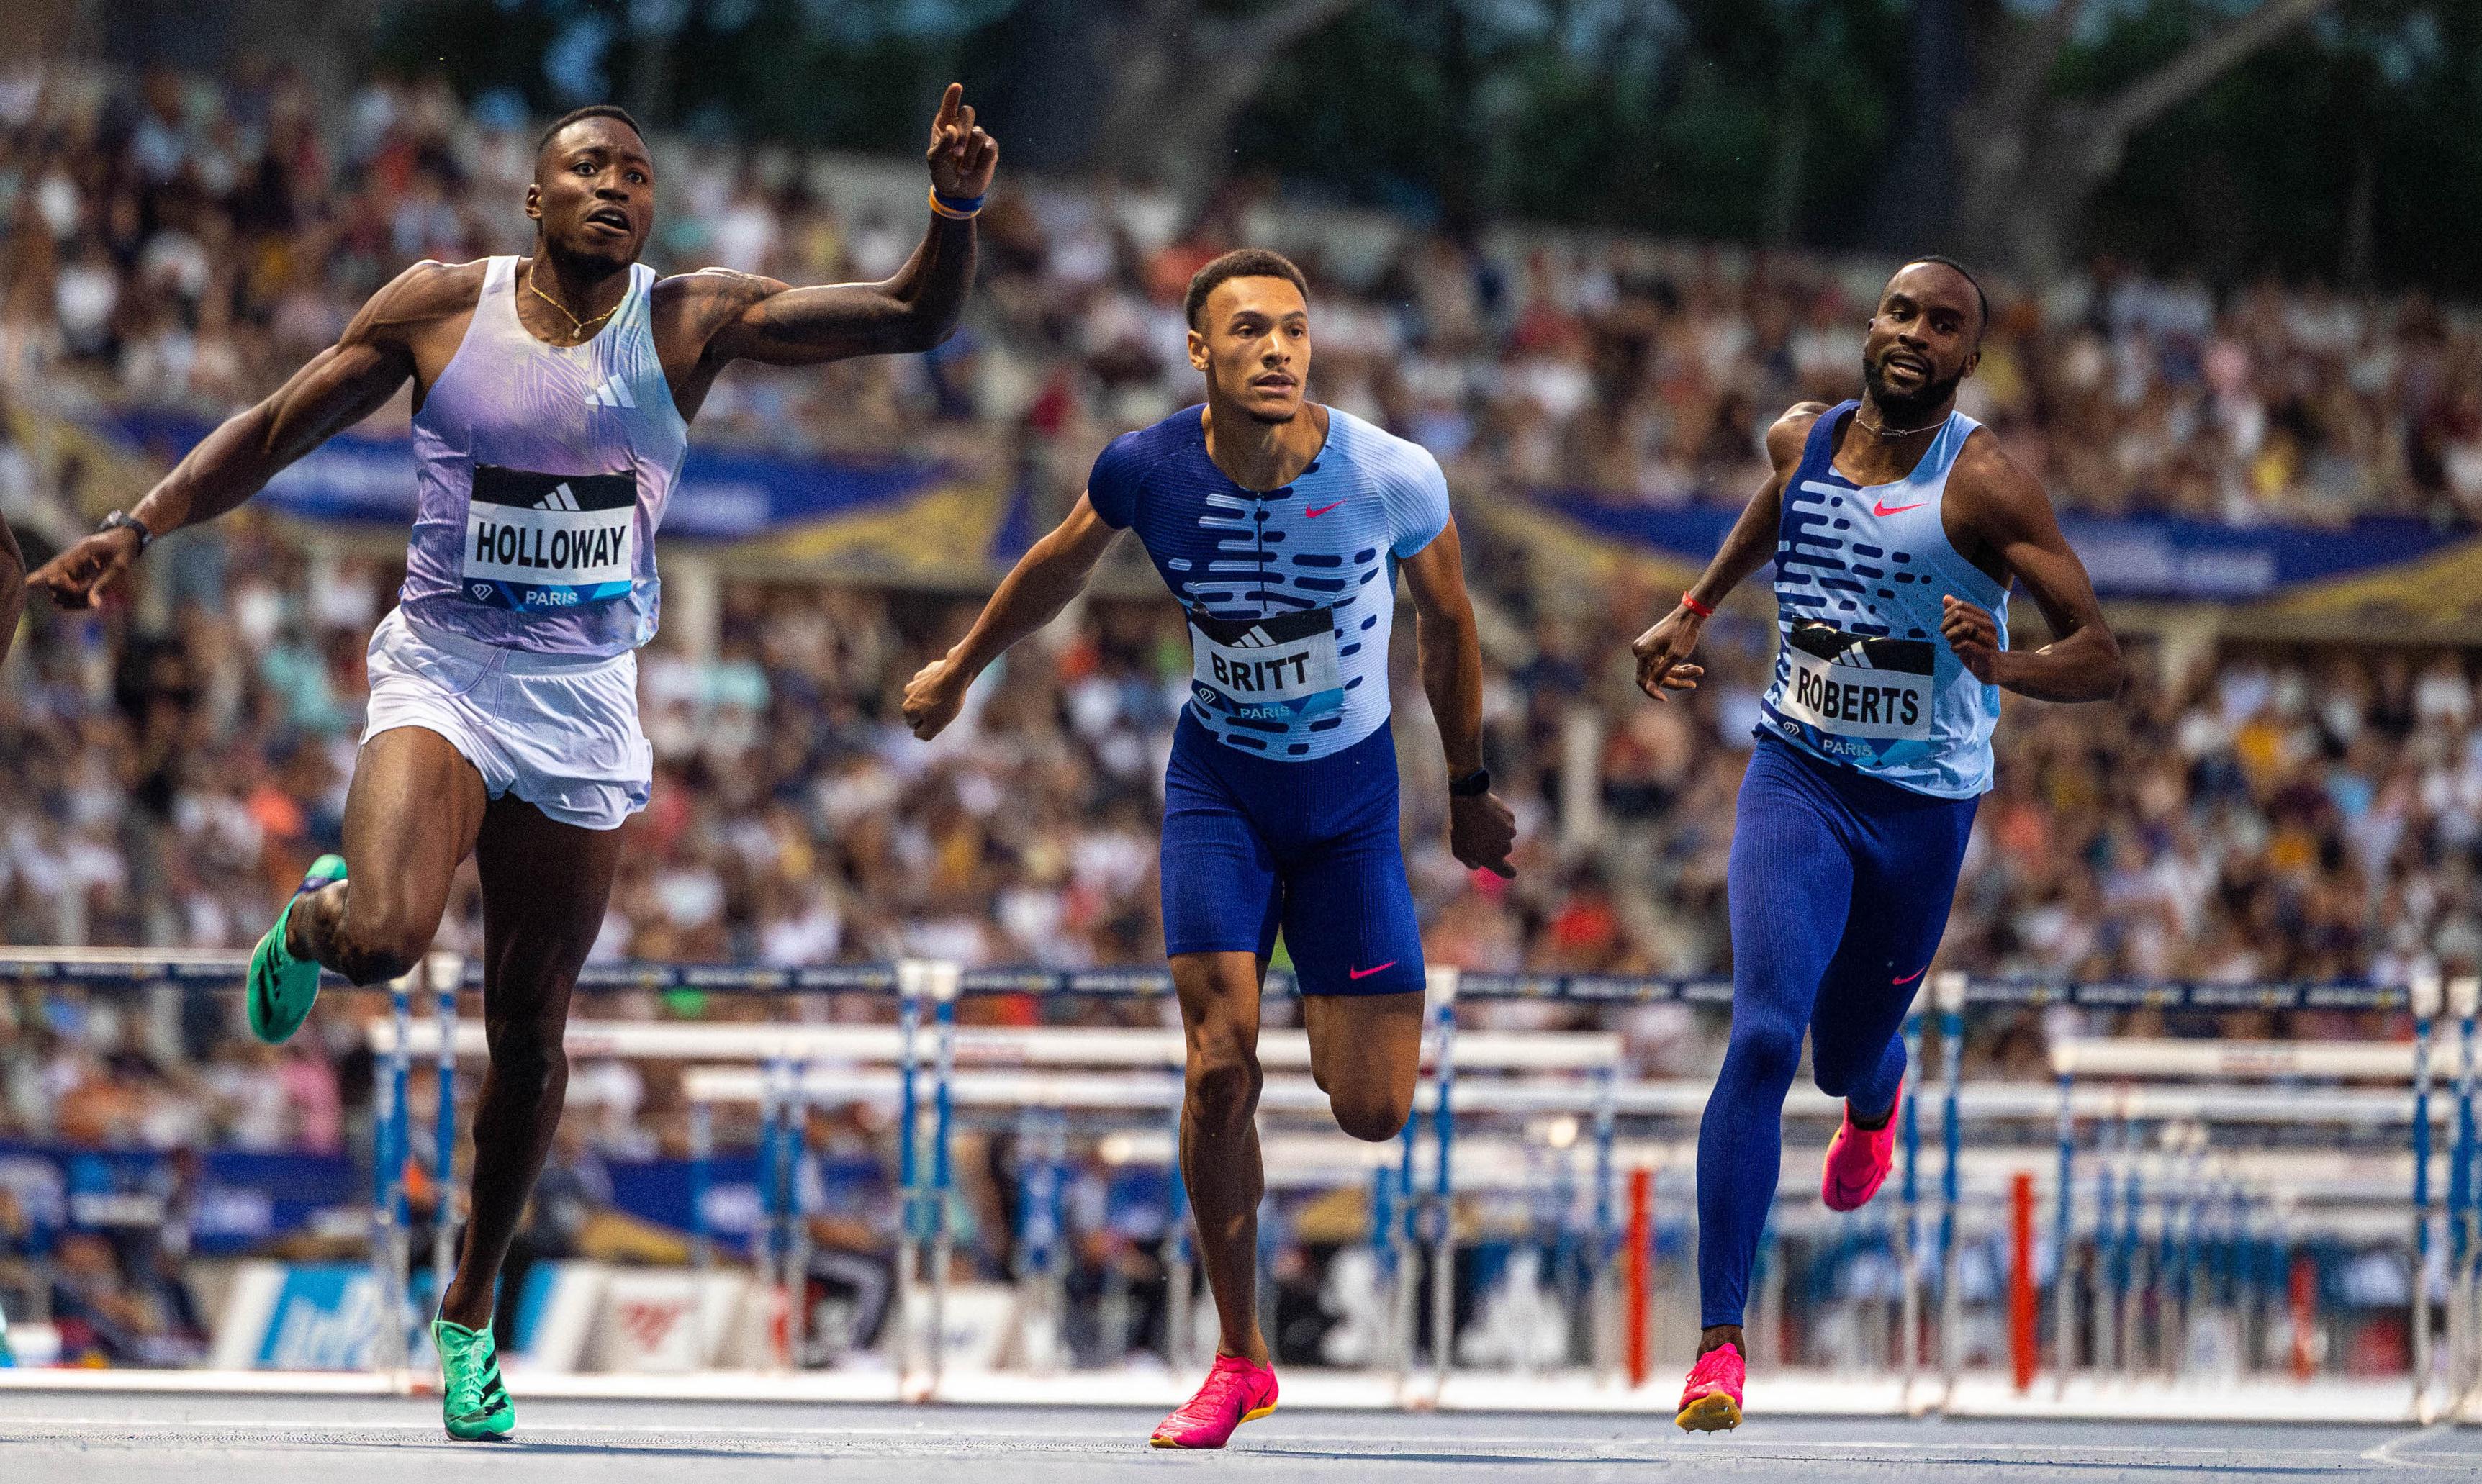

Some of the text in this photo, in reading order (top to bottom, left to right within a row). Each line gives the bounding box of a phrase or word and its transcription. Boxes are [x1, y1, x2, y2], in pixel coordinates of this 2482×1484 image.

[476, 522, 626, 569] HOLLOWAY
[525, 590, 578, 606] PARIS
[1211, 651, 1309, 691] BRITT
[1796, 666, 1918, 725] ROBERTS
[1240, 705, 1291, 719] PARIS
[1823, 739, 1872, 756] PARIS
